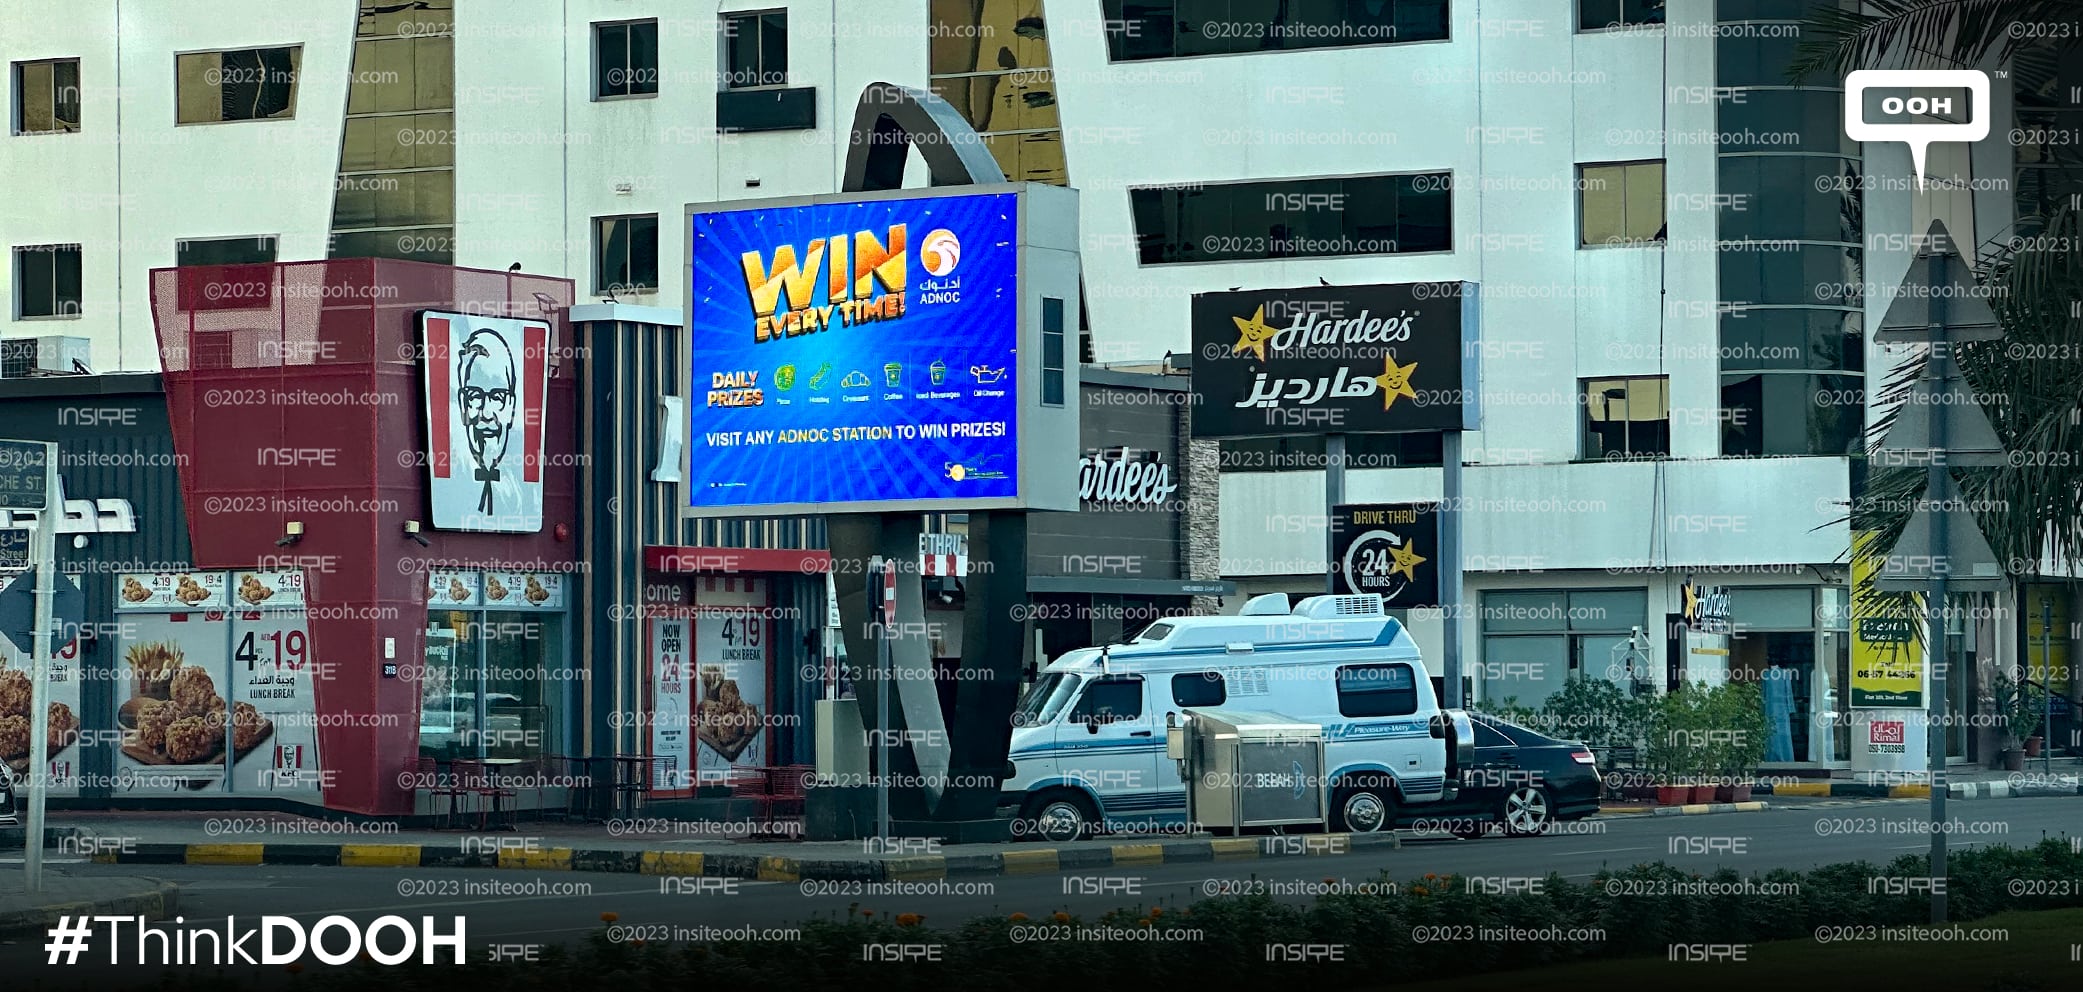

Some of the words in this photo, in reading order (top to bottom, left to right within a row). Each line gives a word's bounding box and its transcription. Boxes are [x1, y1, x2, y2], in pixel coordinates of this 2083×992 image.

[741, 223, 908, 318] WIN
[919, 291, 961, 305] ADNOC
[755, 304, 834, 344] EVERY
[840, 292, 908, 329] TIME!
[1270, 309, 1414, 351] Hardee's
[712, 370, 759, 389] DAILY
[1235, 366, 1378, 408] هارديز
[707, 388, 765, 408] PRIZES
[706, 431, 743, 447] VISIT
[745, 429, 775, 445] ANY
[777, 428, 829, 444] ADNOC
[832, 426, 893, 442] STATION
[895, 424, 916, 440] TO
[919, 423, 948, 439] WIN
[951, 421, 1006, 438] PRIZES!
[25, 474, 44, 491] ST.
[1079, 446, 1178, 505] ardee's
[1353, 510, 1385, 525] DRIVE
[1387, 509, 1417, 524] THRU
[928, 533, 961, 555] THRU
[1362, 548, 1389, 576] 24
[1362, 576, 1391, 587] HOURS
[644, 584, 681, 602] ome
[663, 625, 680, 639] NOW
[722, 618, 734, 647] 4
[741, 617, 760, 648] 19
[235, 632, 258, 671] 4
[271, 630, 307, 671] 19
[662, 639, 681, 653] OPEN
[723, 649, 741, 660] LUNCH
[742, 649, 761, 660] BREAK
[250, 689, 272, 699] LUNCH
[273, 688, 296, 699] BREAK
[661, 683, 681, 695] HOURS
[1354, 725, 1409, 734] Pleasure-Way
[1873, 732, 1901, 742] Rimal
